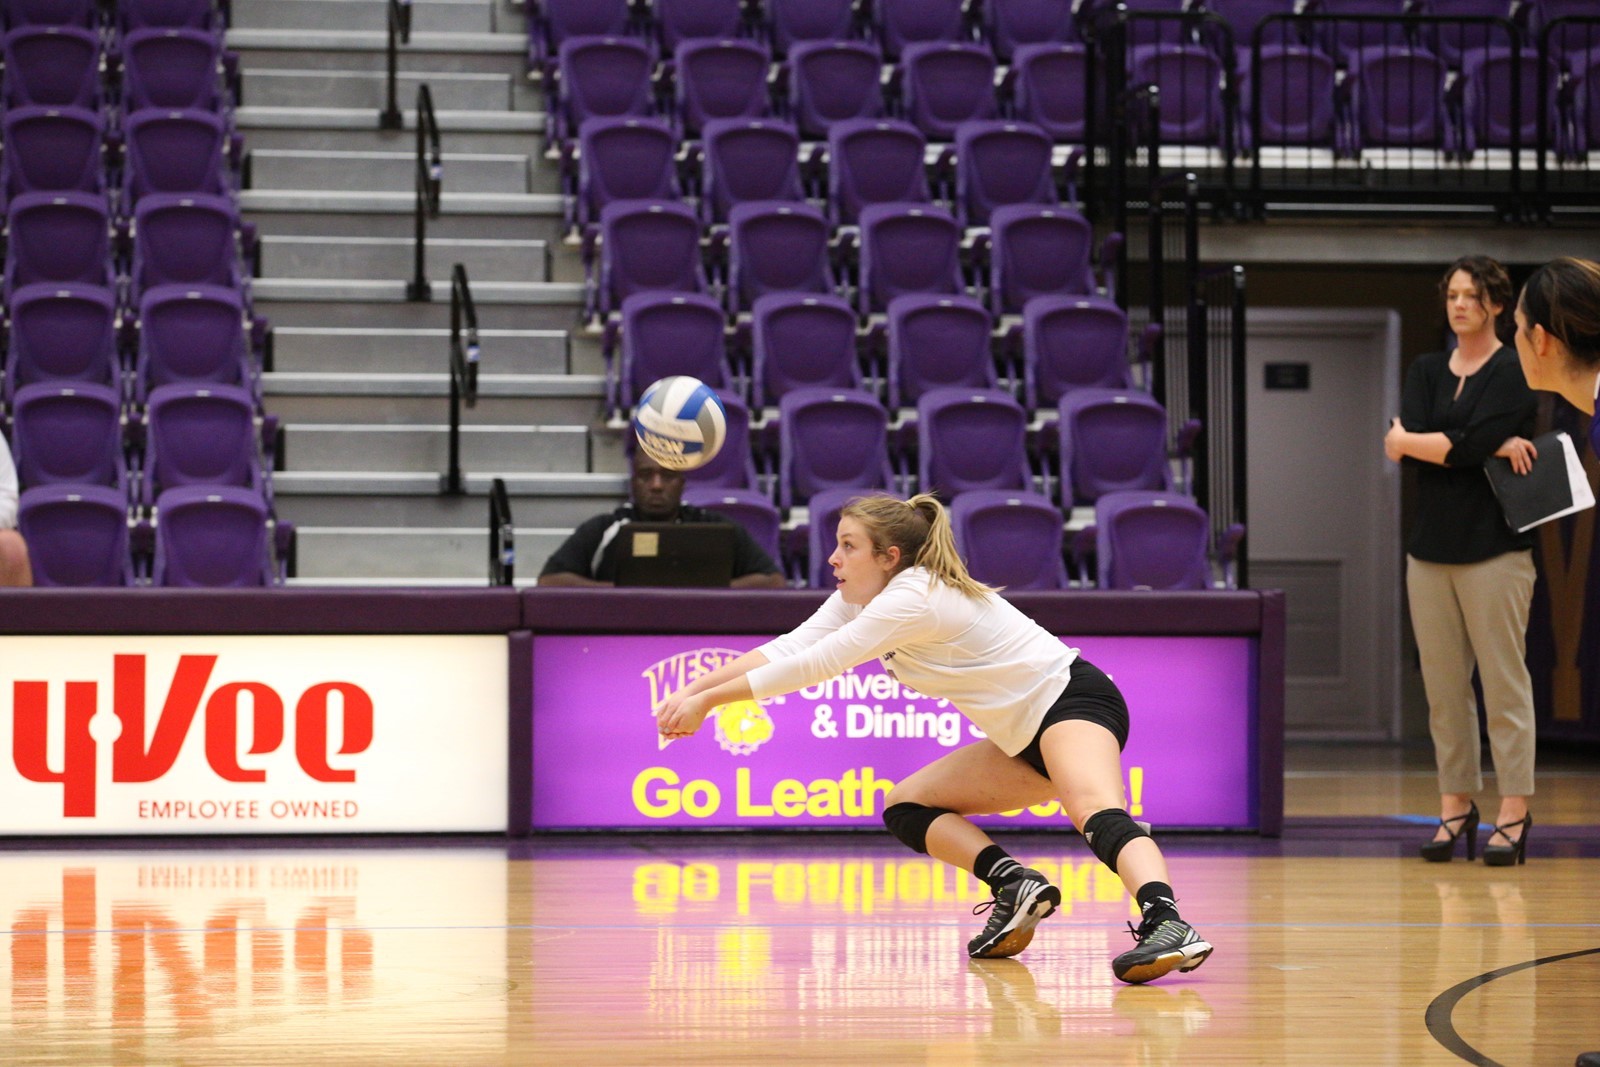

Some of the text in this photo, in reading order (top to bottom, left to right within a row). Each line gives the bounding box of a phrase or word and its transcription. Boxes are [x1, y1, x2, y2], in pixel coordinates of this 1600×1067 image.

[810, 703, 839, 739] &
[845, 704, 961, 747] Dining
[137, 799, 359, 819] EMPLOYEE OWNED
[631, 766, 721, 818] Go
